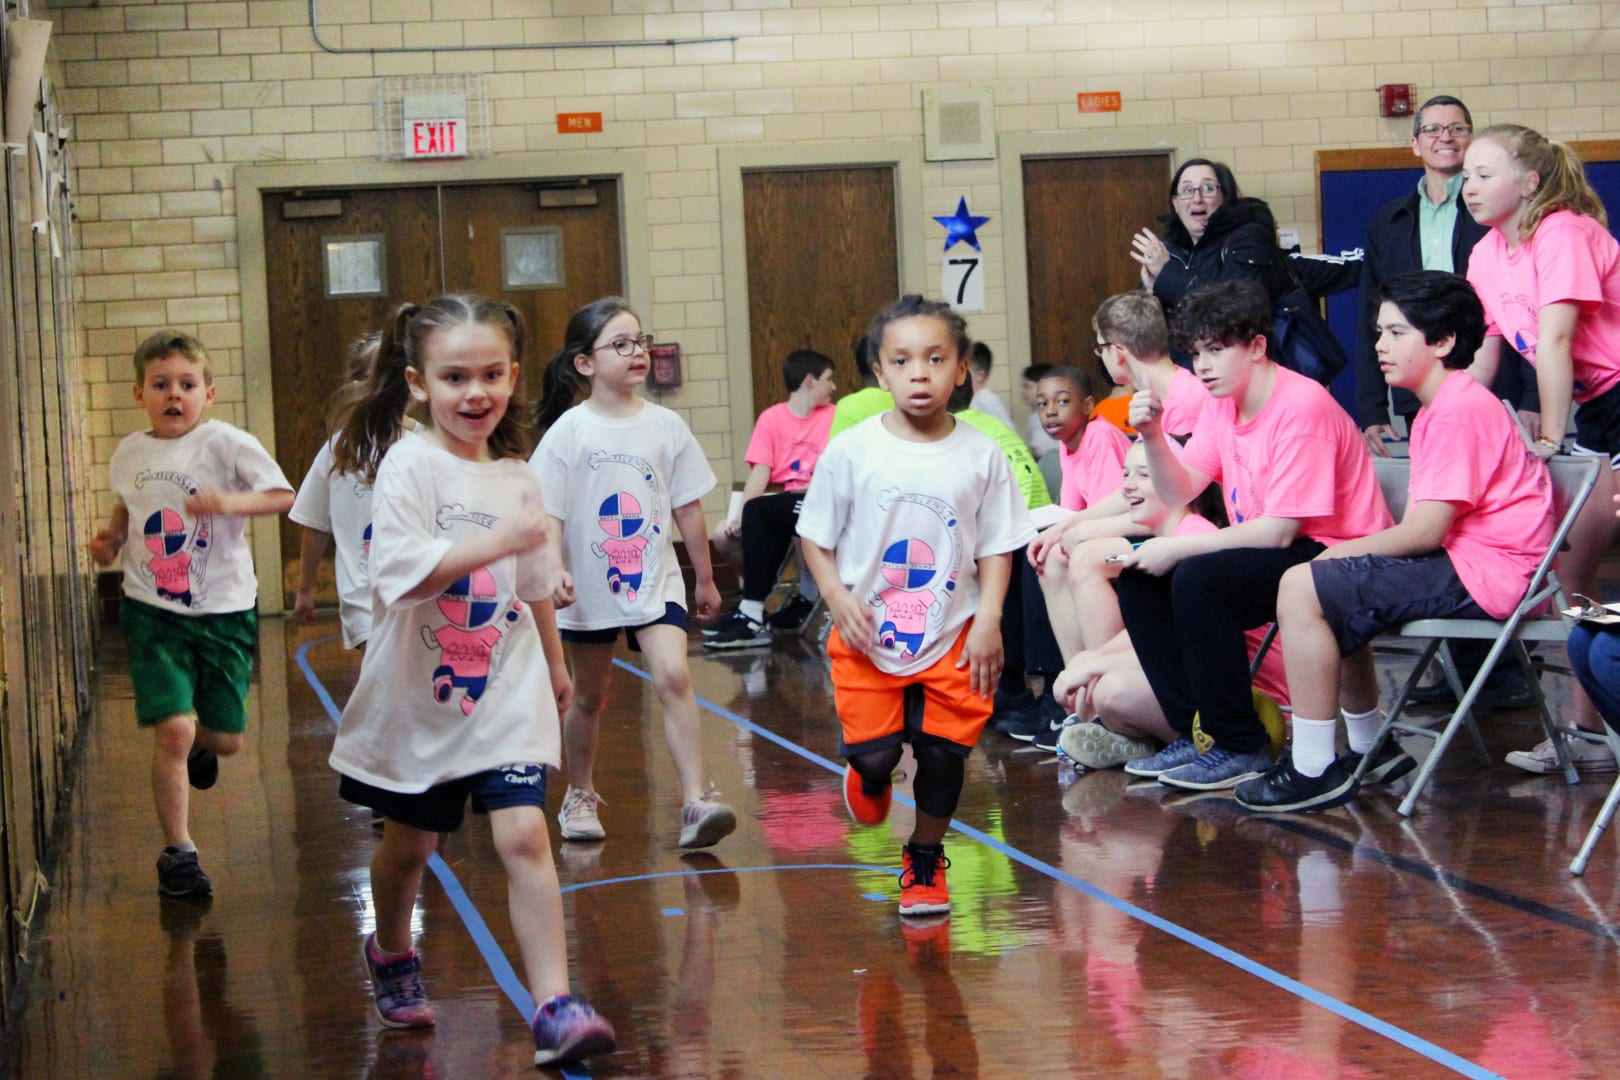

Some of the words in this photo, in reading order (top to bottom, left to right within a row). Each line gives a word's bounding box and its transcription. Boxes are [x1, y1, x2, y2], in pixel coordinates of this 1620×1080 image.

[1080, 95, 1118, 109] LADIES
[568, 116, 592, 129] MEN
[413, 121, 457, 155] EXIT
[948, 257, 979, 305] 7
